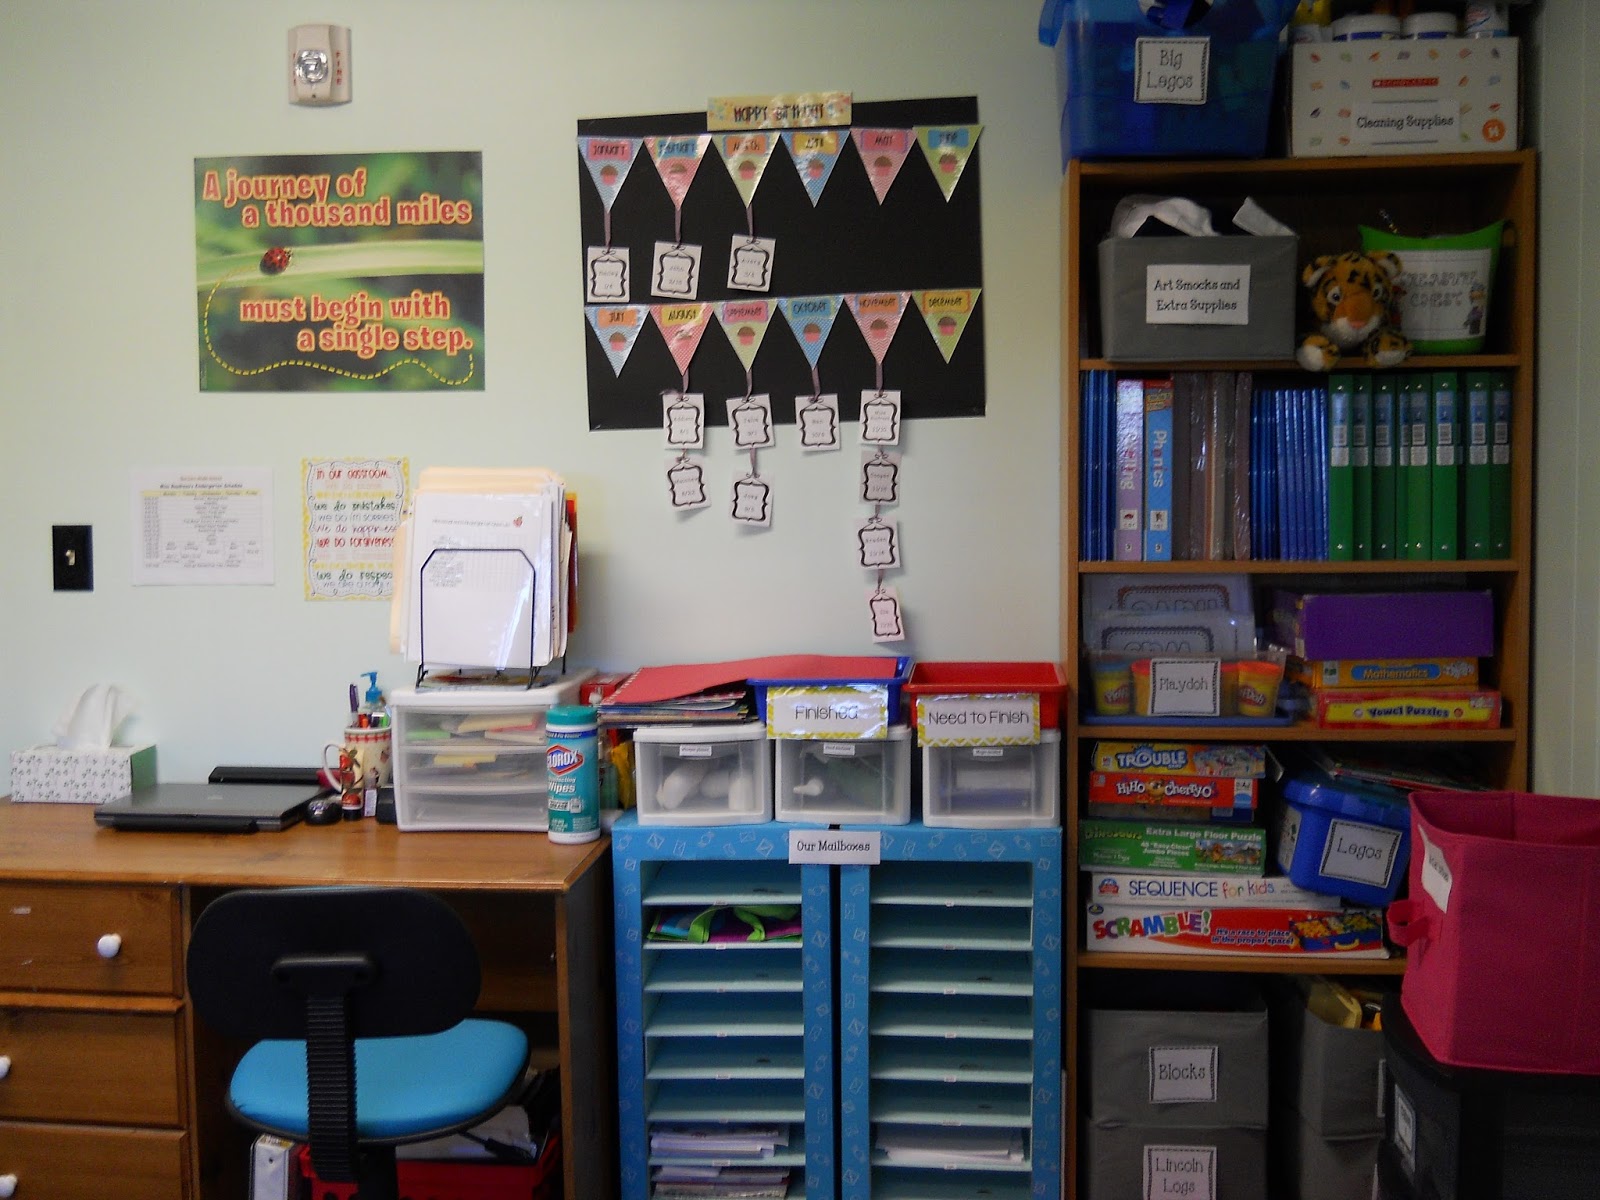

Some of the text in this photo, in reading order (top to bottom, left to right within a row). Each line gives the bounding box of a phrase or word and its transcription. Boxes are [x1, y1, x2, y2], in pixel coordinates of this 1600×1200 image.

[1160, 49, 1183, 71] Big
[1146, 71, 1194, 93] Legos
[1357, 114, 1454, 131] Cleaning Supplies
[203, 166, 367, 208] A journey of
[242, 193, 472, 228] a thousand miles
[1154, 278, 1240, 291] Art Smocks and
[240, 290, 450, 329] must begin with
[1156, 299, 1237, 314] Extra Supplies
[297, 323, 473, 359] a single step.
[1153, 430, 1168, 488] Phonics
[1364, 668, 1429, 680] Mathematics
[1159, 678, 1208, 694] Playdoh
[795, 705, 858, 720] Finished
[929, 710, 1029, 725] Need to Finish
[1369, 706, 1450, 718] Vowel Puzzles
[1117, 750, 1186, 768] TROUBLE
[1146, 828, 1172, 837] Extra
[1175, 829, 1201, 840] Large
[1204, 830, 1229, 840] Floor
[1231, 830, 1262, 841] Puzzle
[796, 840, 871, 852] Our Mailboxes
[1336, 837, 1383, 861] Legos
[1129, 880, 1218, 897] SEQUENCE
[1222, 880, 1244, 899] for
[1247, 879, 1274, 896] kids
[1093, 909, 1212, 940] SCRAMBLE!
[1237, 937, 1265, 945] proper
[1268, 929, 1291, 938] place
[1159, 1063, 1206, 1081] Blocks
[1156, 1157, 1204, 1173] Lincoln
[1163, 1178, 1195, 1196] Logs
